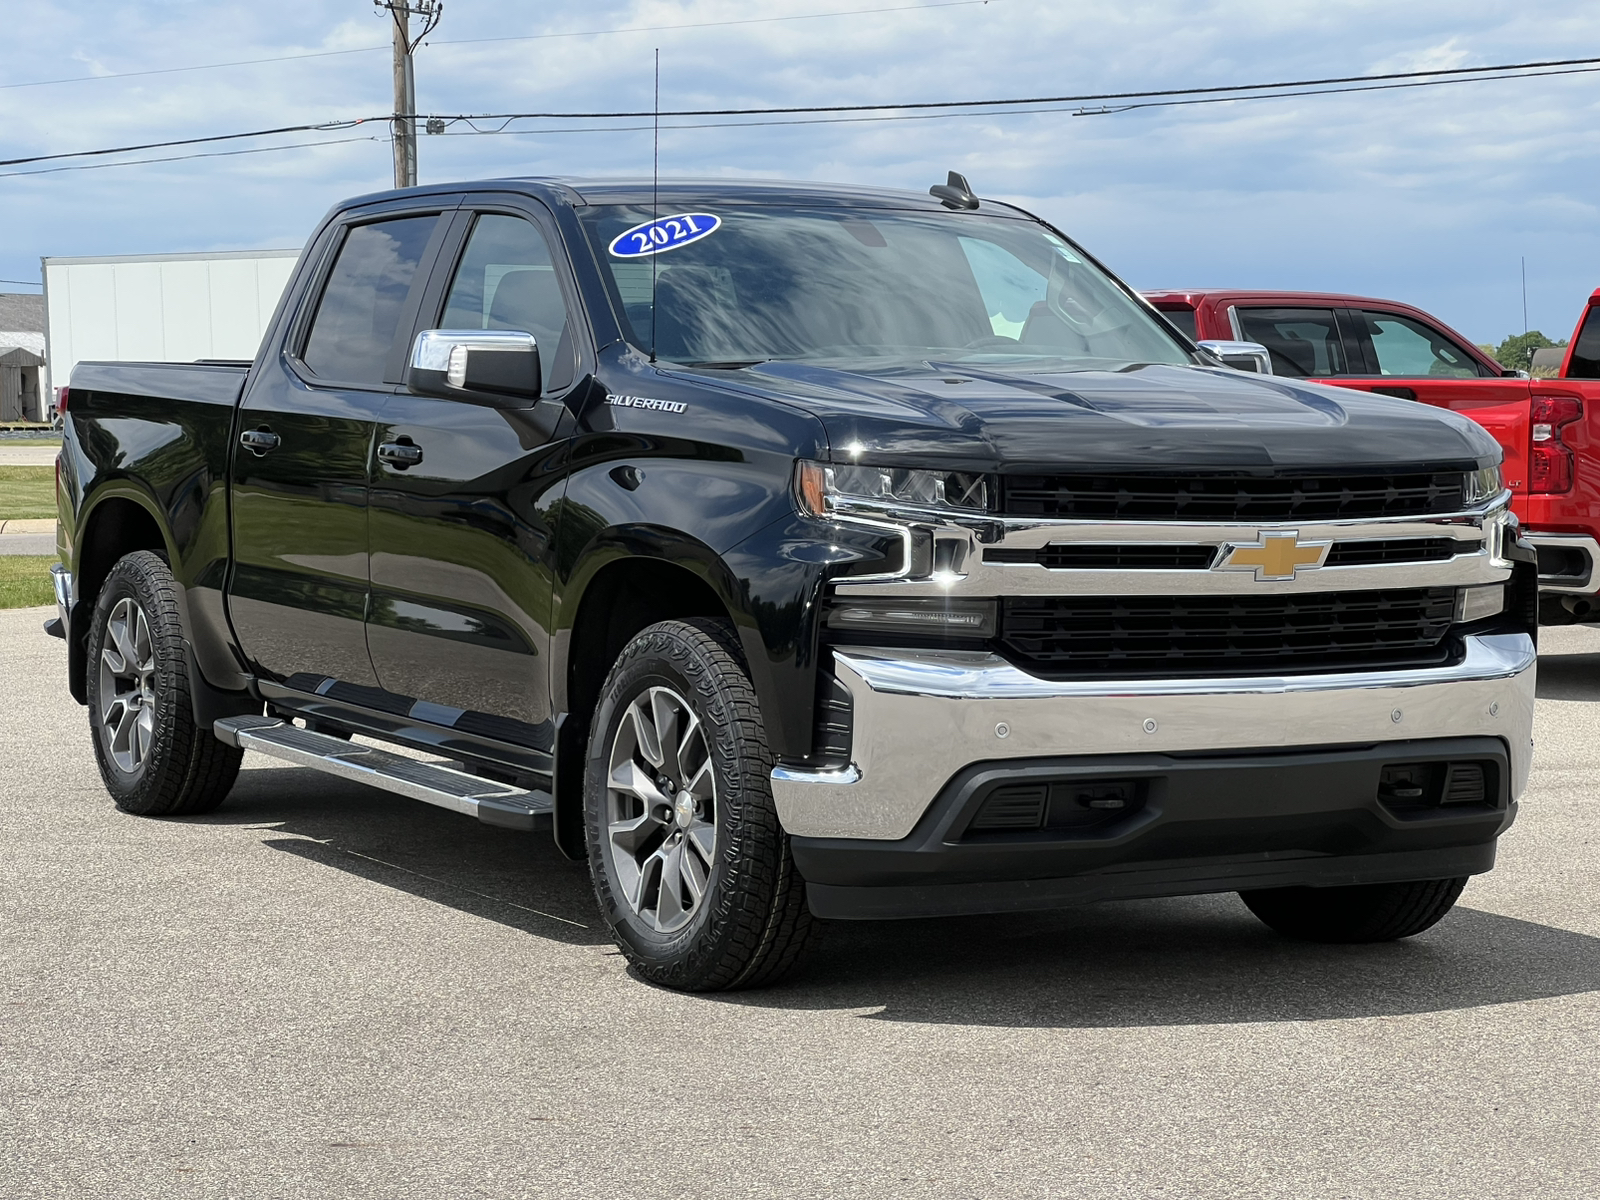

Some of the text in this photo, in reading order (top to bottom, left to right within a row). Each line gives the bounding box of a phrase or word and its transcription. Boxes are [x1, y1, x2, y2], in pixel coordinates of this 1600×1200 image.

[631, 215, 702, 253] 2021
[604, 394, 688, 414] SILVERADO
[1508, 479, 1522, 487] LT
